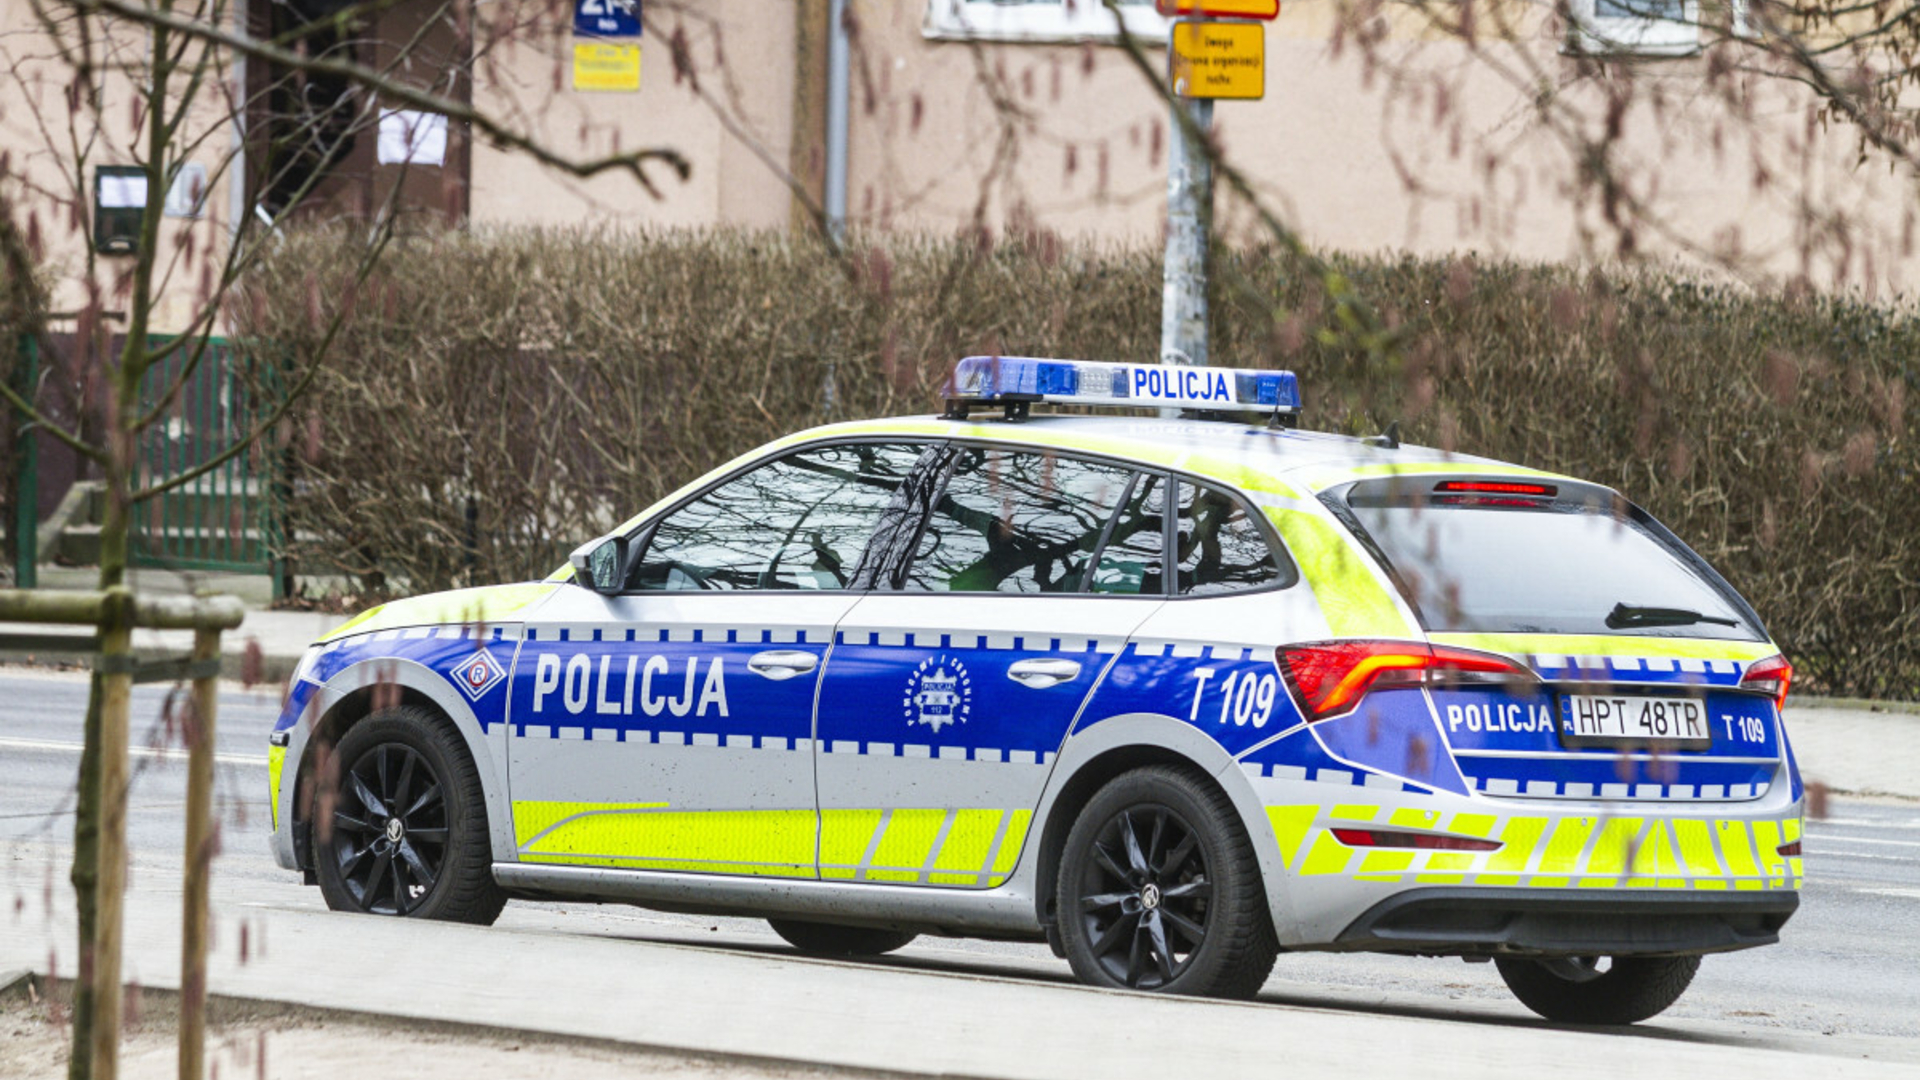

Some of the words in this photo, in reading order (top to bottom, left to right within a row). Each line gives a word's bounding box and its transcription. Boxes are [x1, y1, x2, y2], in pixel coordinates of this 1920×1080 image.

[1134, 368, 1230, 401] POLICJA
[473, 667, 484, 681] R
[532, 653, 730, 717] POLICJA
[924, 682, 953, 691] POLICJA
[930, 705, 943, 714] 112
[1190, 667, 1216, 721] T
[1219, 670, 1276, 729] 109
[1446, 704, 1555, 733] POLICJA
[1578, 698, 1626, 735] HPT
[1639, 700, 1701, 738] 48TR
[1721, 714, 1734, 741] T
[1738, 716, 1766, 744] 109
